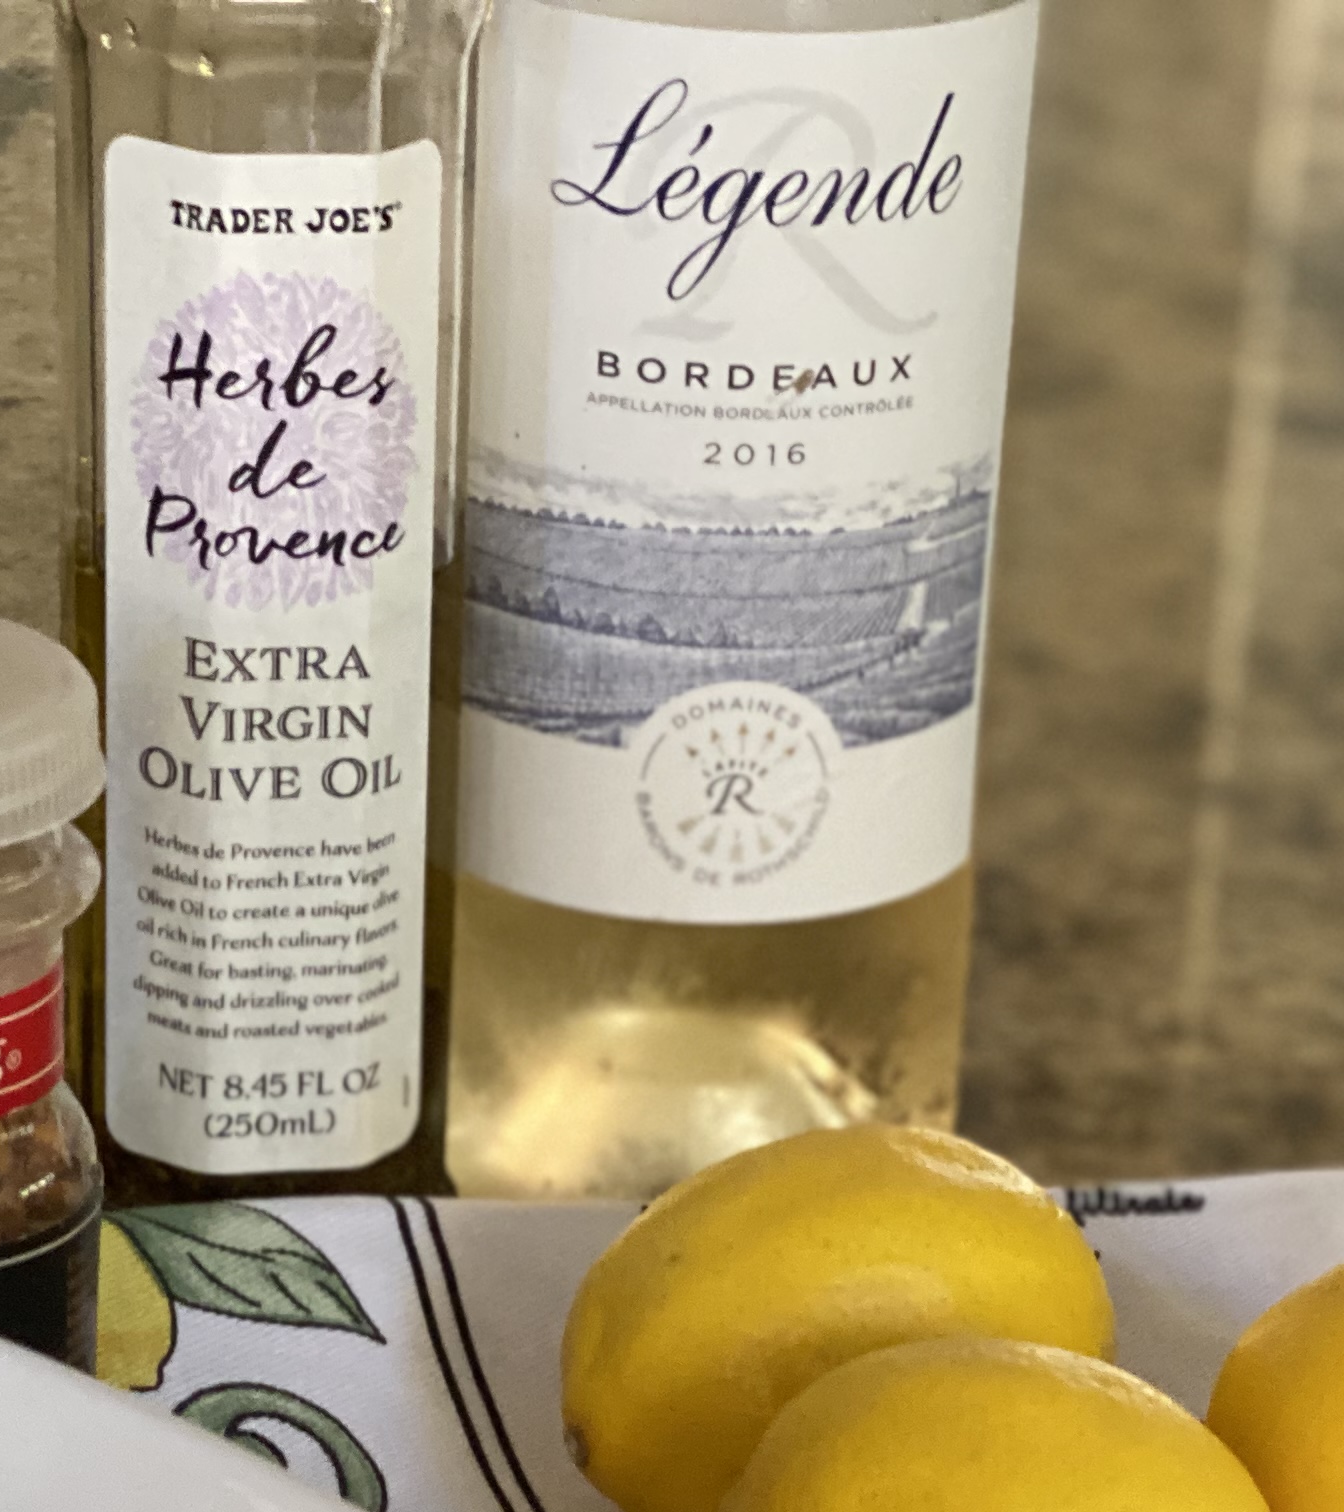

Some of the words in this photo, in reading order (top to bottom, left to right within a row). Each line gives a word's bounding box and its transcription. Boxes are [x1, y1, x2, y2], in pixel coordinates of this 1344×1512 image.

[551, 78, 962, 299] Légende
[170, 199, 294, 234] TRADER
[304, 202, 395, 234] JOE'S
[159, 323, 393, 409] Herbes
[597, 351, 912, 391] BORDEAUX
[586, 391, 706, 418] APPELLATION
[228, 421, 326, 498] de
[704, 442, 806, 466] 2016
[144, 484, 404, 569] Provence
[671, 697, 802, 729] DOMAINES
[144, 826, 200, 857] Herbes
[203, 842, 224, 860] de
[231, 843, 315, 861] Provence
[321, 839, 362, 857] have
[367, 832, 396, 852] been
[152, 863, 198, 887] added
[203, 875, 221, 890] to
[227, 871, 288, 891] French
[294, 870, 342, 888] Extra
[348, 863, 390, 887] Virgin
[137, 886, 176, 911] Olive
[180, 899, 204, 919] Oil
[209, 906, 227, 920] to
[233, 905, 289, 920] create
[295, 906, 306, 918] a
[310, 902, 370, 920] unique
[372, 889, 400, 911] olive
[136, 918, 154, 935] oil
[158, 925, 187, 943] rich
[191, 930, 206, 949] in
[212, 932, 273, 950] French
[278, 930, 350, 951] culinary
[149, 950, 193, 976] Great
[198, 961, 223, 980] for
[133, 975, 189, 1008] dipping
[193, 993, 224, 1010] and
[230, 991, 307, 1011] drizzling
[313, 993, 352, 1007] over
[147, 1010, 192, 1036] meats
[195, 1023, 229, 1039] and
[233, 1020, 300, 1039] roasted
[159, 1062, 213, 1098] NET
[223, 1073, 287, 1101] 8.45
[297, 1071, 333, 1097] FL
[342, 1061, 381, 1092] OZ
[204, 1109, 337, 1139] (250mL)
